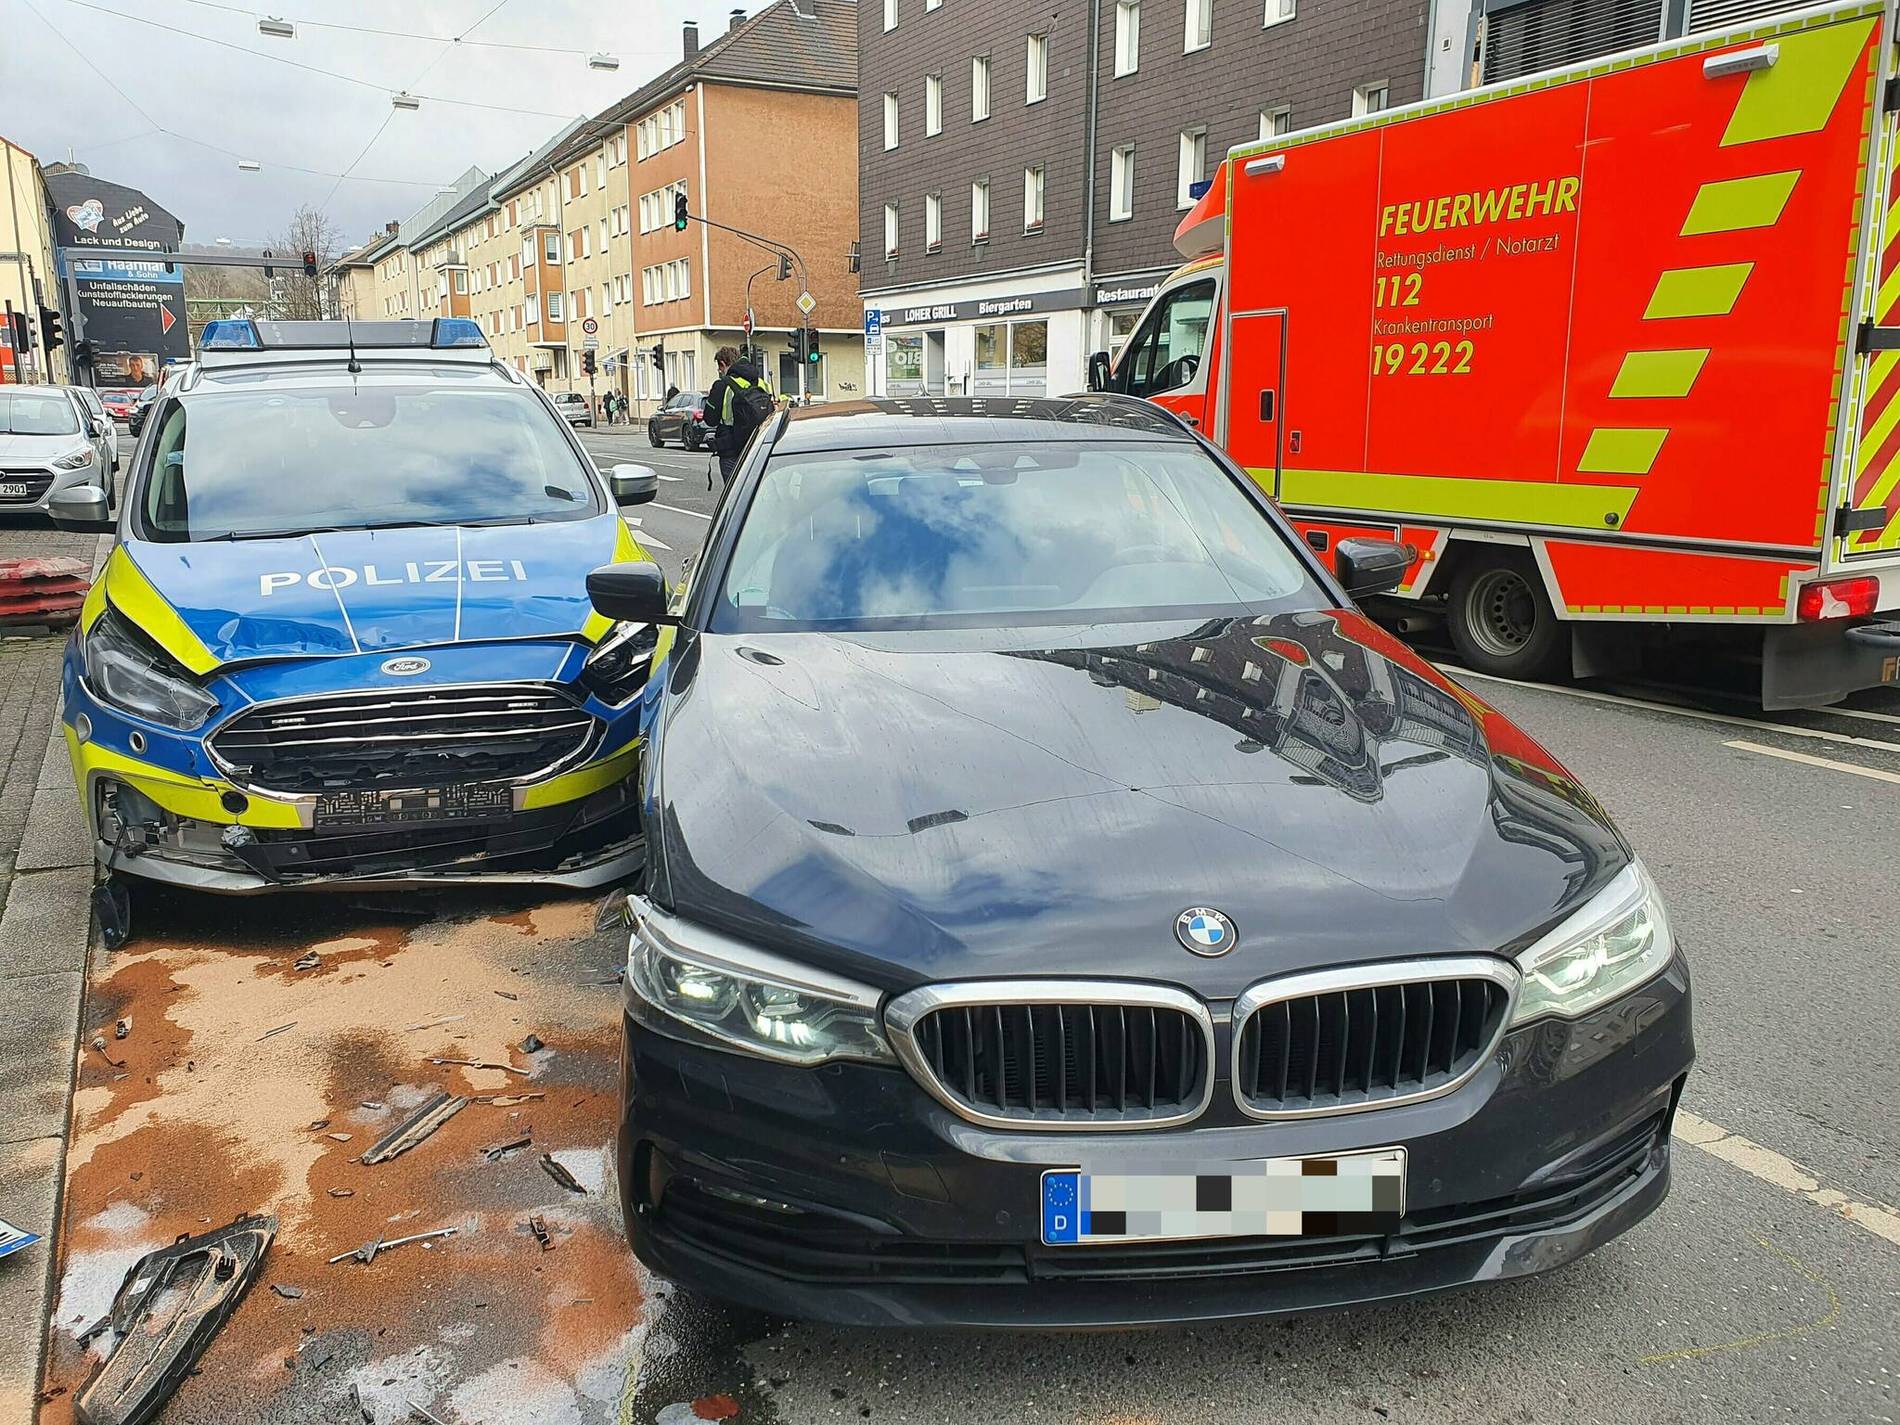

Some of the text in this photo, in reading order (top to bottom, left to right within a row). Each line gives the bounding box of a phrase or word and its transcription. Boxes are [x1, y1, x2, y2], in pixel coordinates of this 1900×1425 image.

[1379, 176, 1580, 237] FEUERWEHR
[112, 216, 126, 227] Aus
[119, 212, 150, 234] zum Auto
[74, 235, 160, 250] Lack und Design
[1377, 243, 1476, 270] Rettungsdienst
[1496, 233, 1559, 256] Notarzt
[136, 271, 158, 279] Sohn
[89, 281, 156, 292] Unfallschäden
[1096, 283, 1160, 303] Restaurant
[1375, 272, 1423, 308] 112
[92, 299, 158, 309] Neuaufbauten
[978, 298, 1032, 314] Biergarten
[866, 311, 875, 323] P
[905, 307, 931, 322] LOHER
[932, 305, 957, 319] GRILL
[585, 322, 595, 331] 30
[1373, 314, 1493, 336] Krankentransport
[2, 484, 26, 494] 2901
[260, 559, 528, 597] POLIZEI
[1180, 908, 1226, 924] BMW
[1054, 1214, 1068, 1231] D
